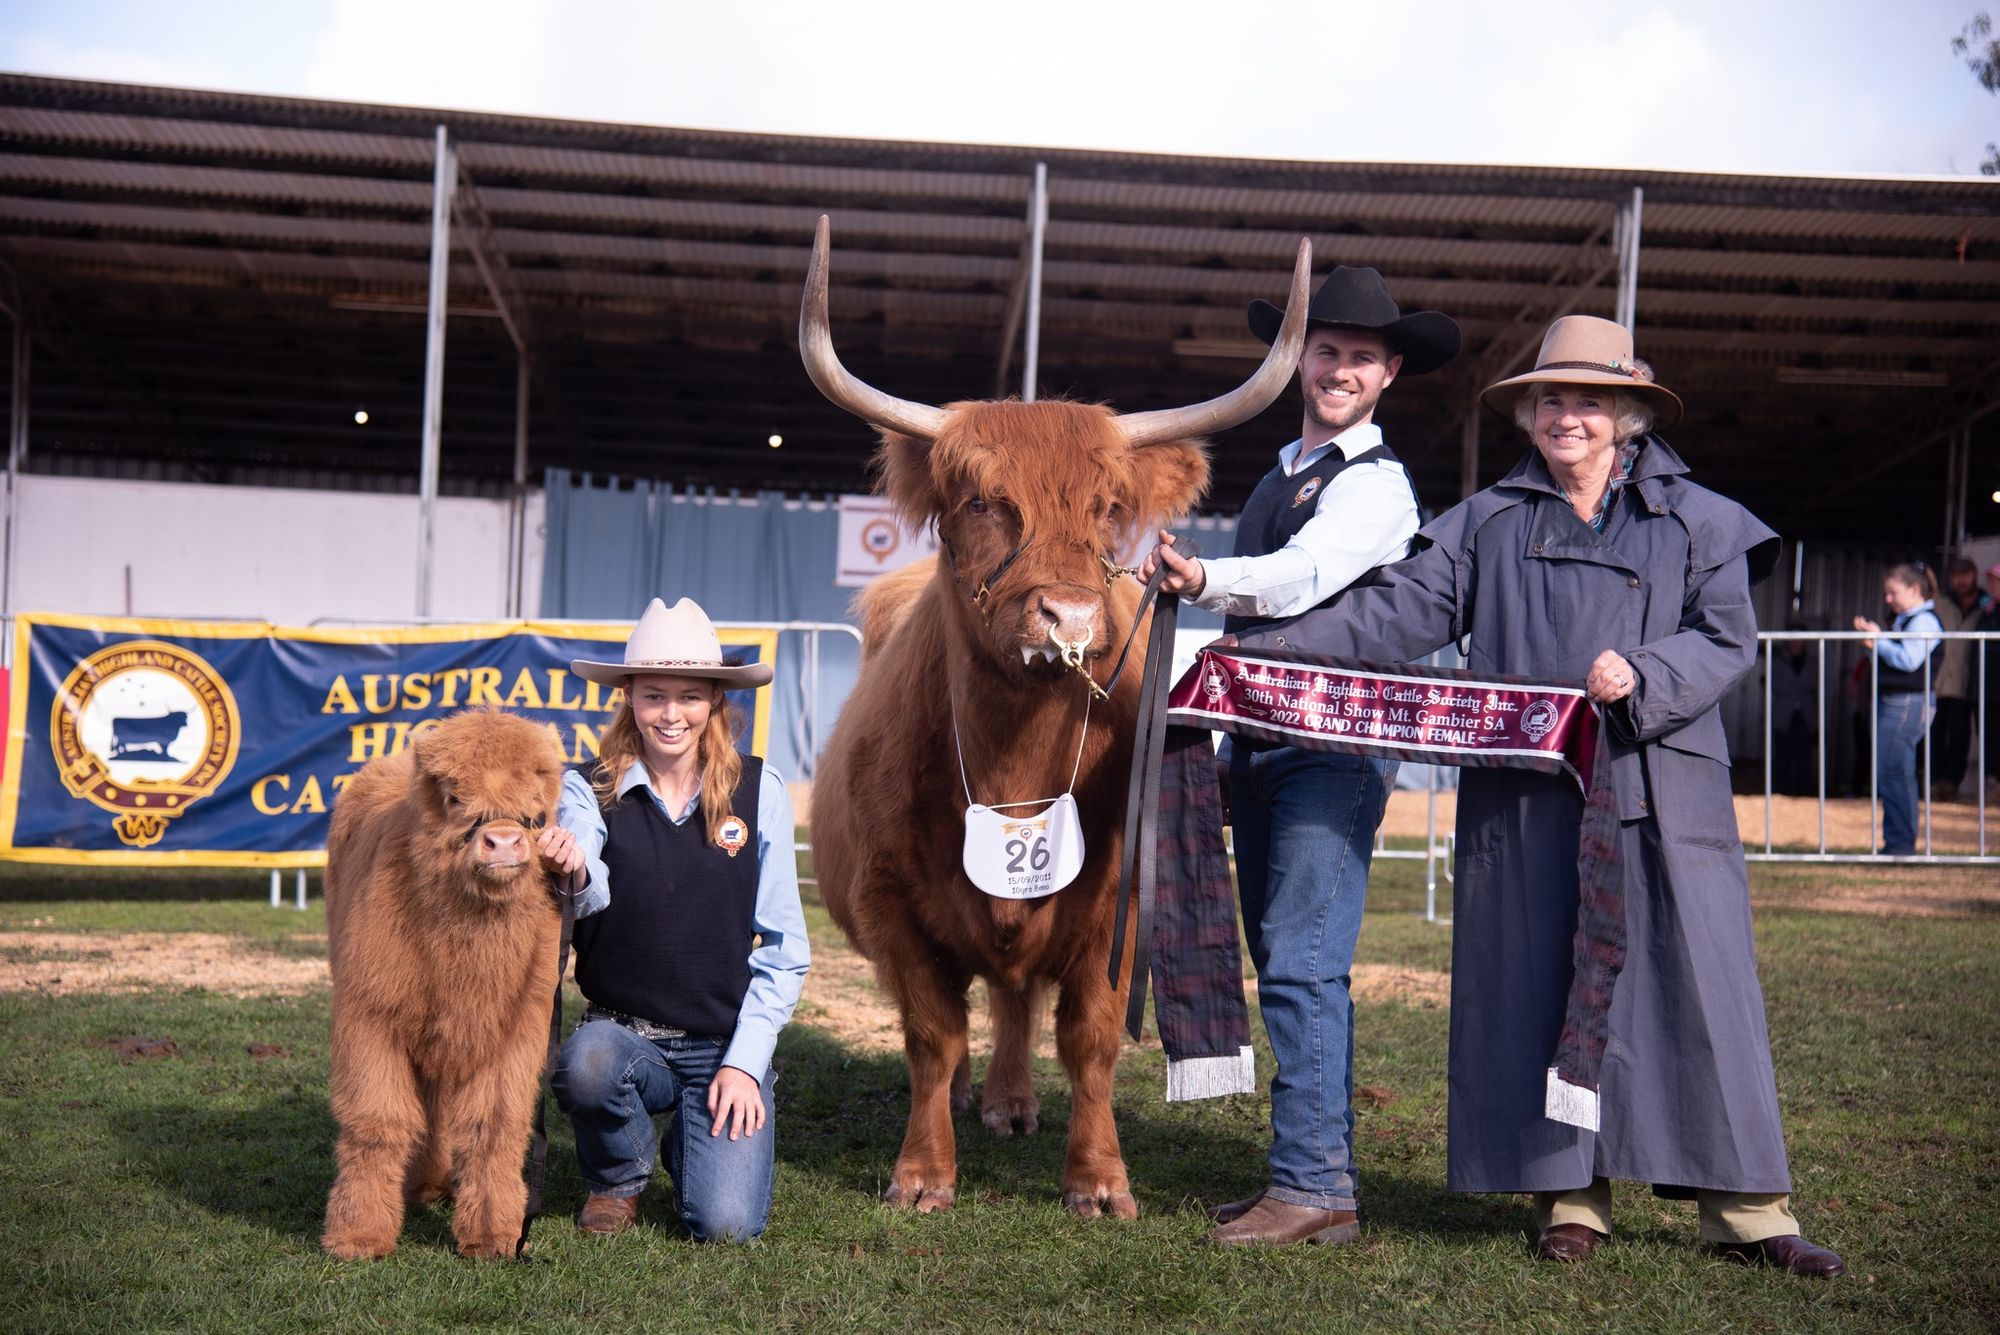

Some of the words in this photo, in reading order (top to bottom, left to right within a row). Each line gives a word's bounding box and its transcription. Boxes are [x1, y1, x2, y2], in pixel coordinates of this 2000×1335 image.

[321, 667, 626, 714] AUSTRALIA
[1234, 666, 1311, 691] Australian
[1312, 676, 1378, 700] Highland
[1383, 686, 1422, 704] Cattle
[1422, 689, 1482, 713] Society
[1483, 694, 1519, 713] Inc.
[1244, 688, 1274, 705] 30th
[1277, 693, 1340, 715] National
[1344, 703, 1386, 720] Show
[1387, 707, 1412, 723] Mt.
[1415, 709, 1481, 729] Gambier
[1483, 716, 1505, 731] SA
[1270, 709, 1301, 726] 2022
[1304, 714, 1352, 733] GRAND
[1355, 720, 1424, 741] CHAMPION
[1427, 727, 1478, 745] FEMALE
[1005, 836, 1050, 874] 26
[1008, 872, 1052, 885] 15/09/2011
